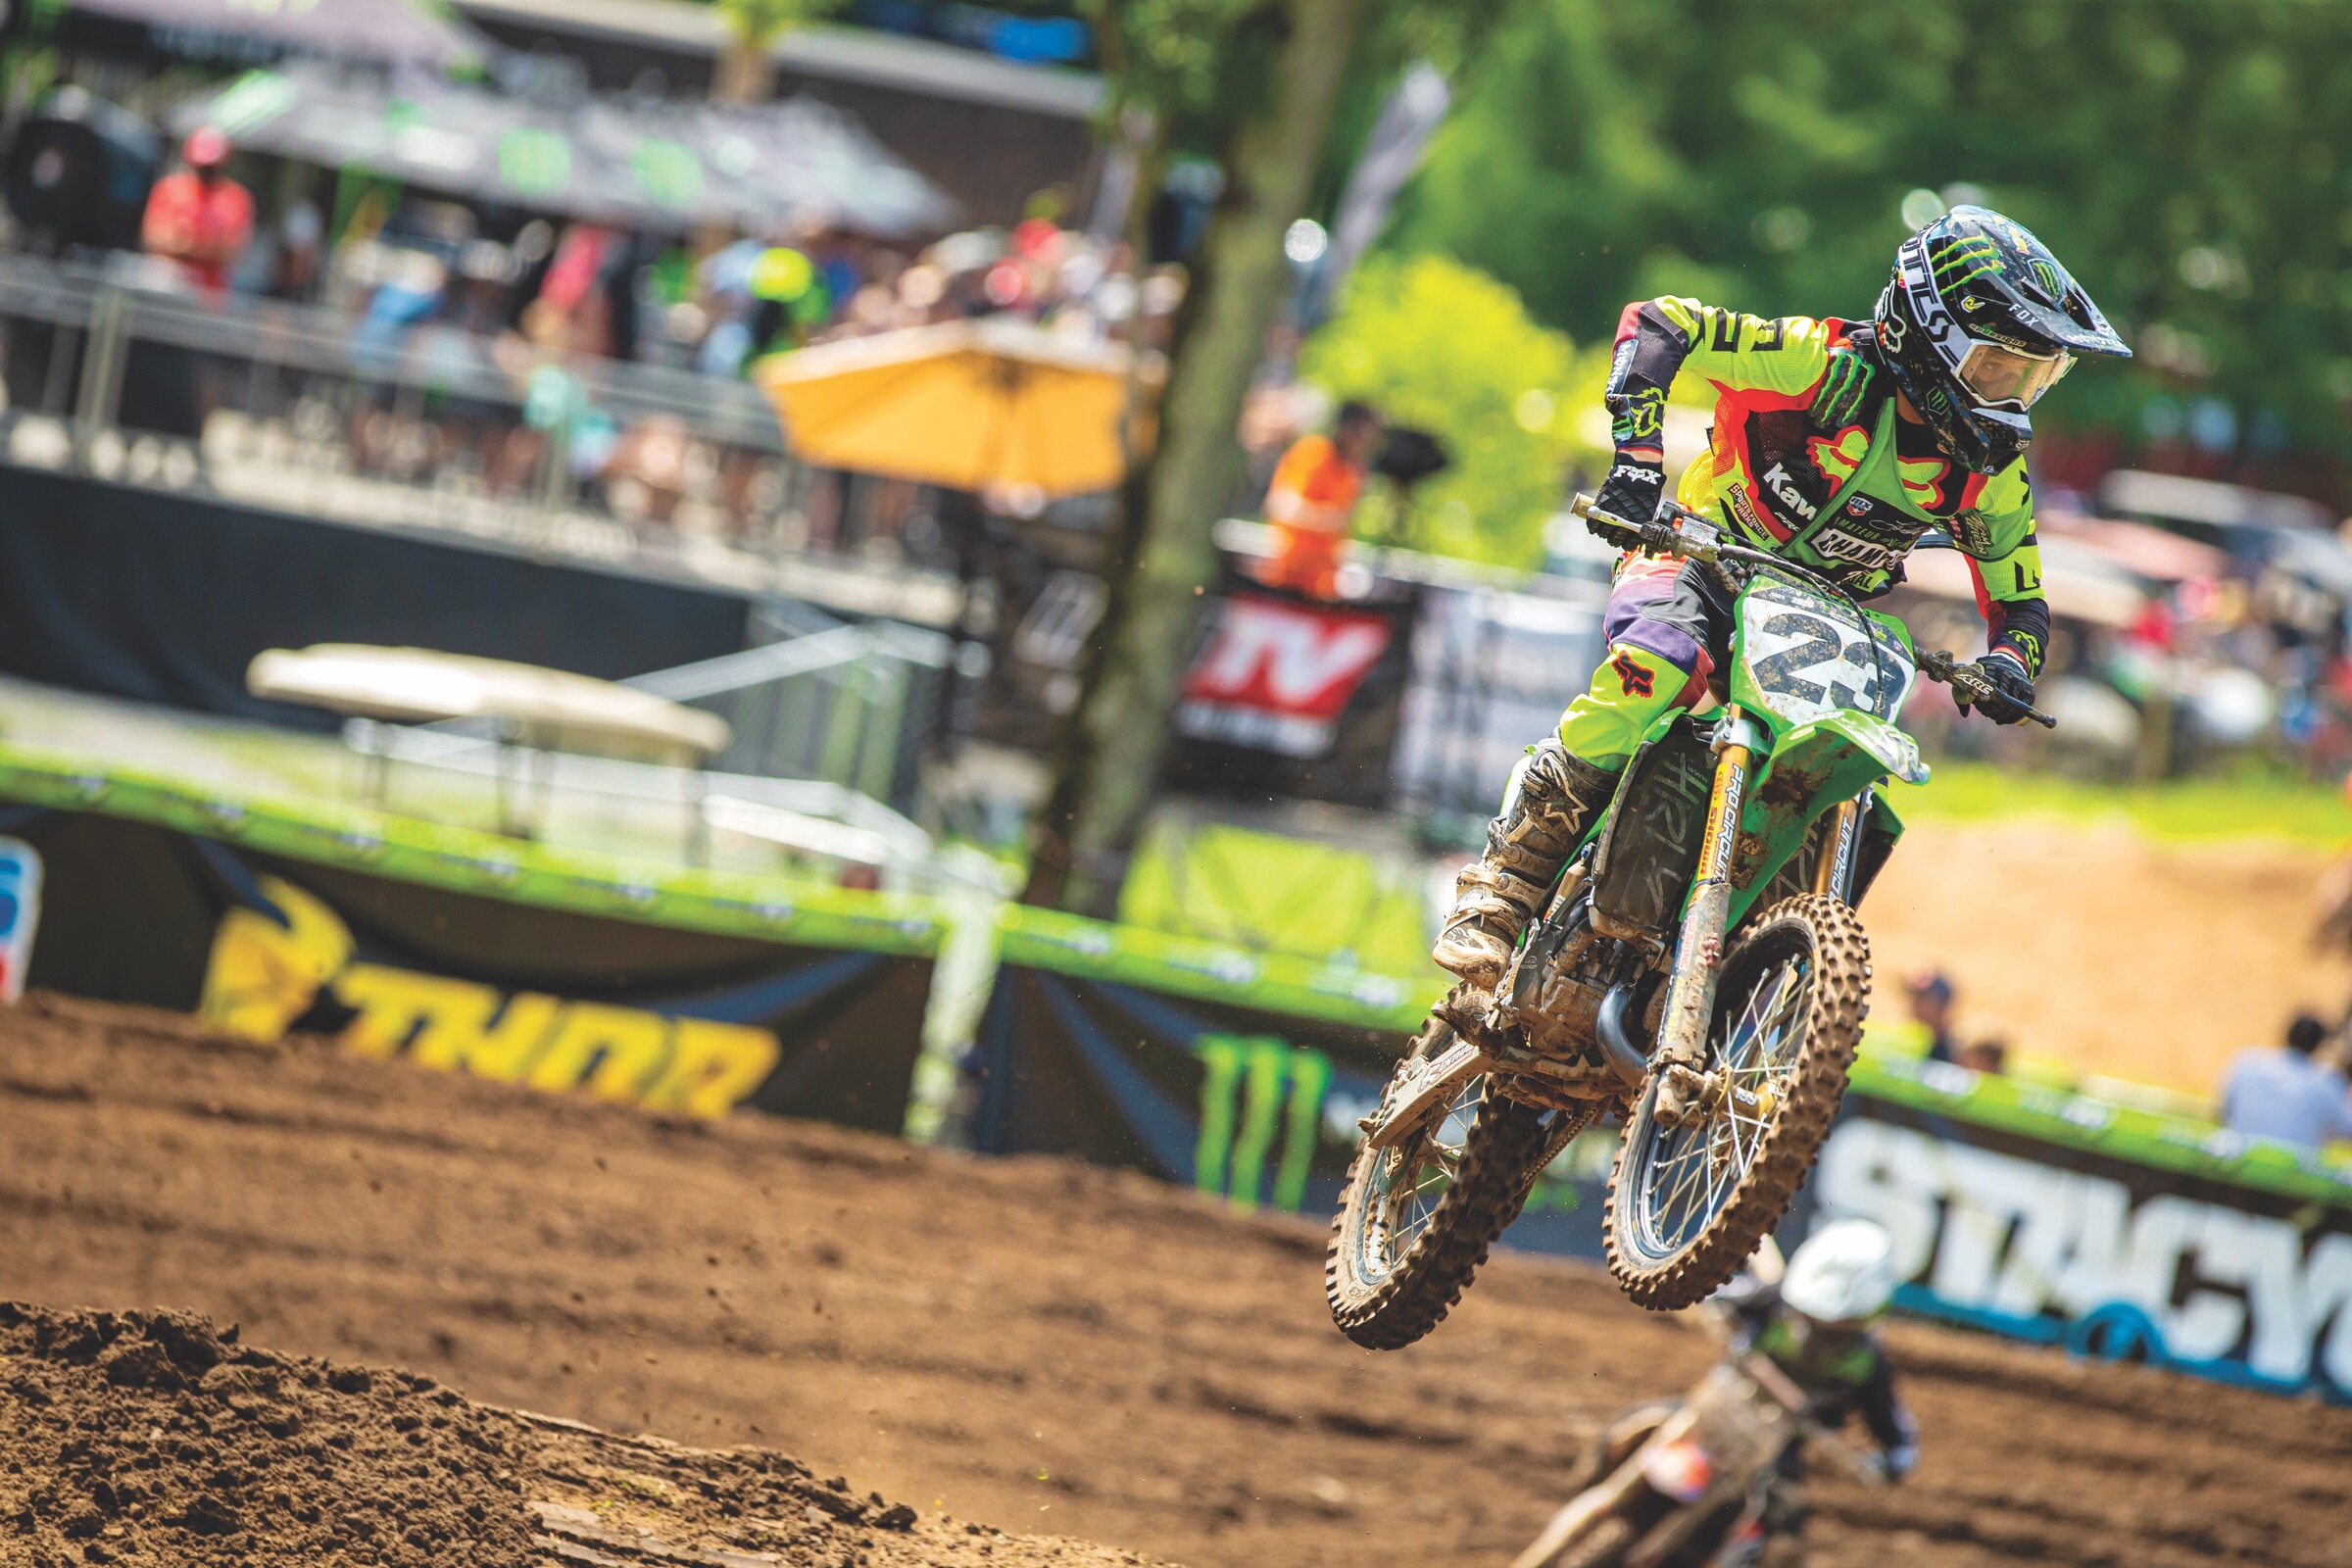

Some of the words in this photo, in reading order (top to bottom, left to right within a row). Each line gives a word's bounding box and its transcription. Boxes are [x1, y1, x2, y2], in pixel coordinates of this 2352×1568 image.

[2008, 303, 2040, 327] FOX
[1614, 464, 1662, 485] FOX
[1734, 503, 1753, 527] PARKS
[1964, 515, 1987, 555] GREEN
[1970, 514, 1991, 545] TEAM
[1211, 600, 1388, 706] TV
[1954, 672, 1994, 695] ARC
[1726, 762, 1745, 810] PRO
[1700, 807, 1718, 875] SHOWA
[1713, 807, 1738, 882] CIRCUIT
[1830, 815, 1853, 899] CIRCUIT
[331, 958, 780, 1120] THOR
